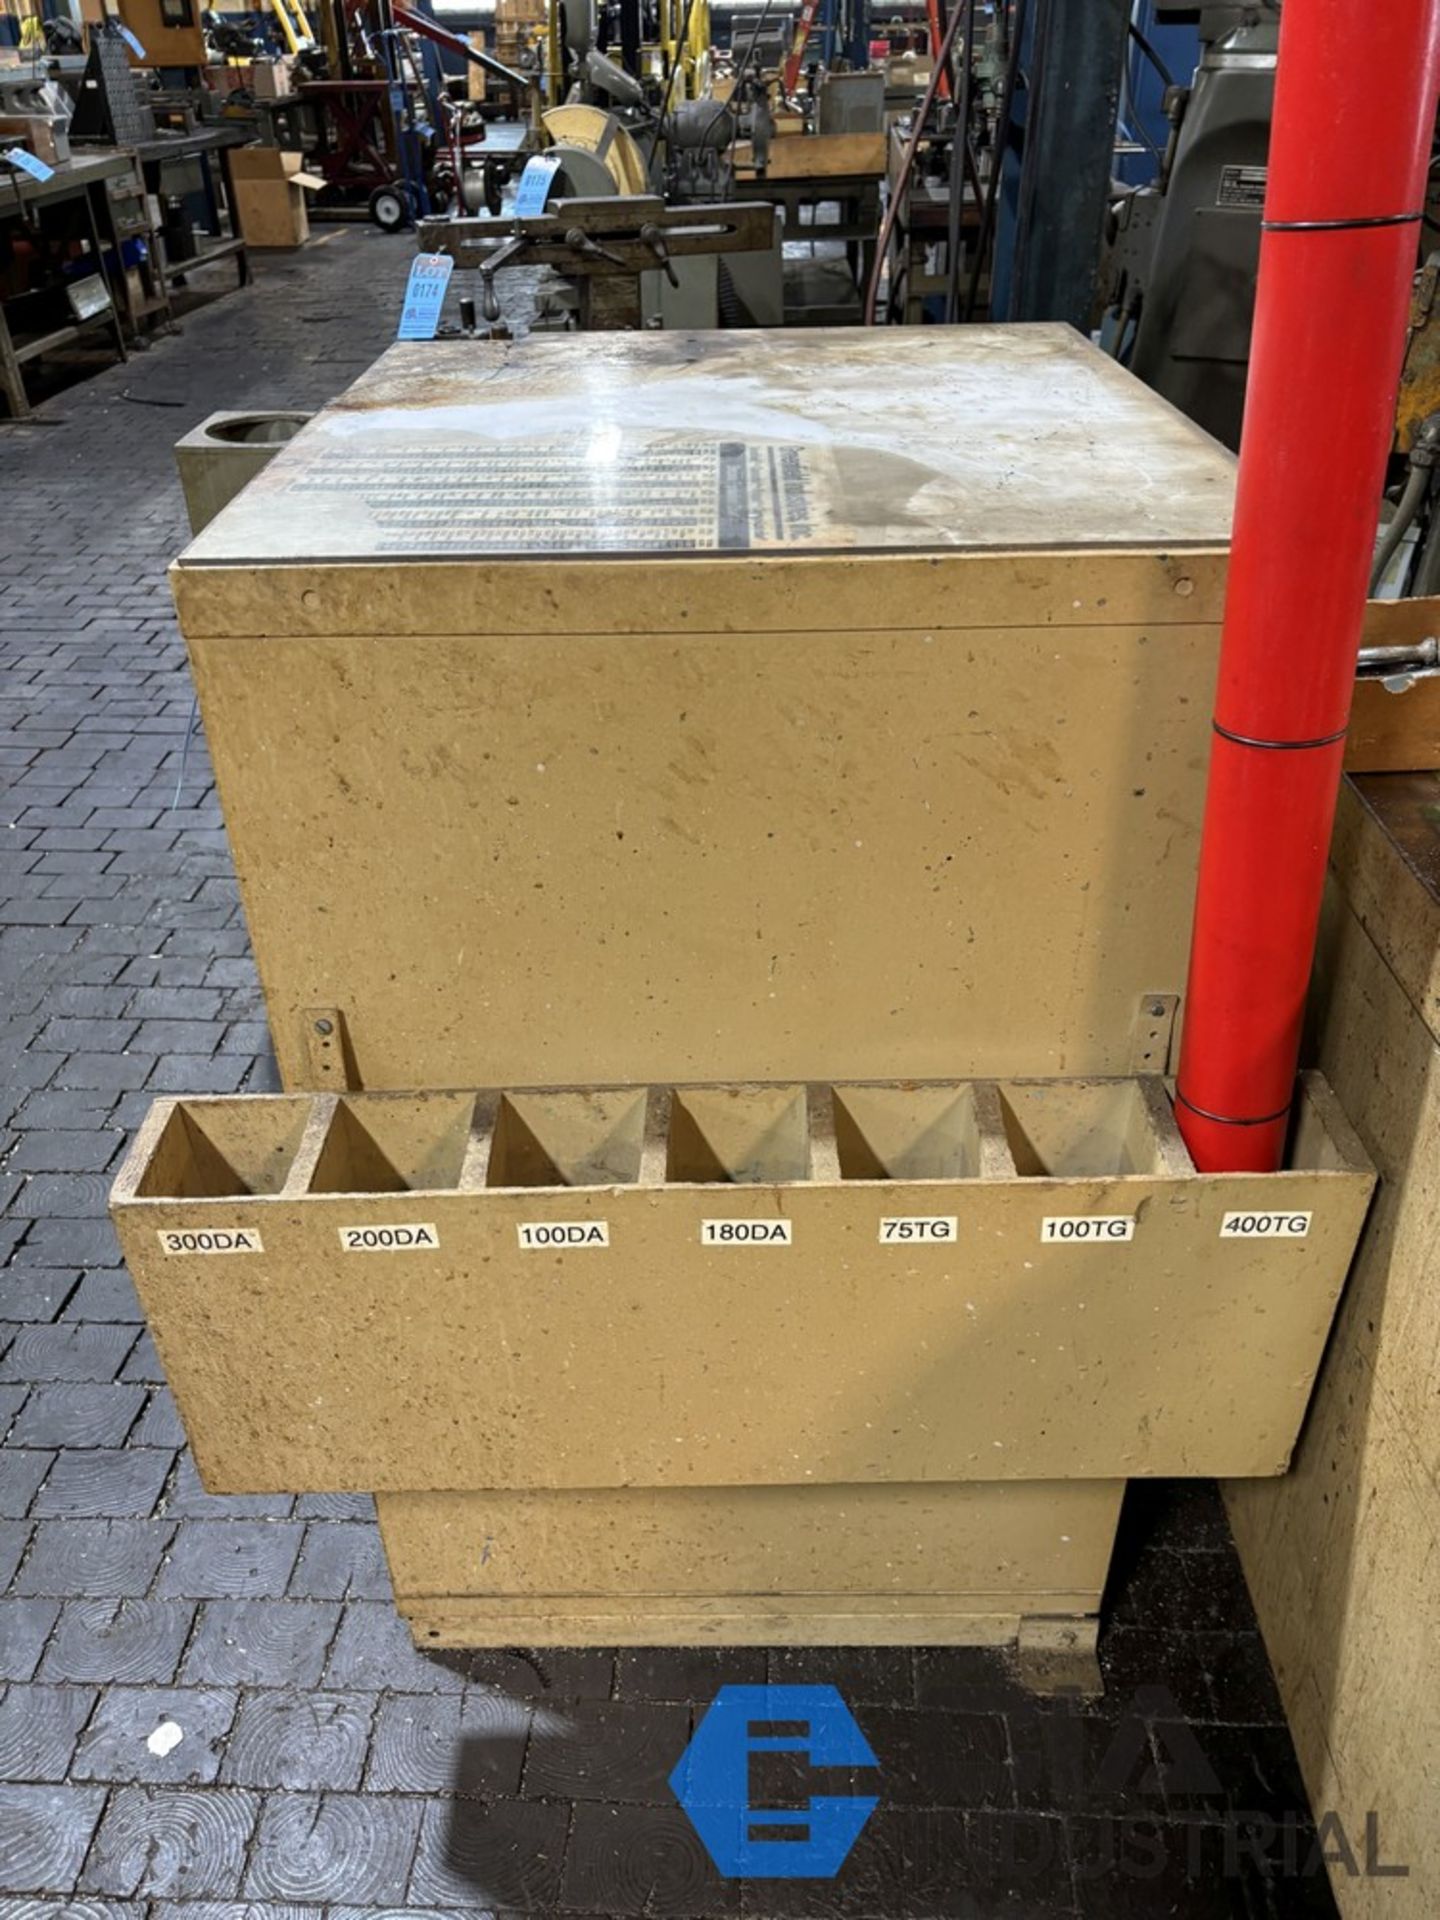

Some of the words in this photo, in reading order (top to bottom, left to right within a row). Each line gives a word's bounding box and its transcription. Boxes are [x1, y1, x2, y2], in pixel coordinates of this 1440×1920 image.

[412, 283, 440, 298] 0174
[706, 1224, 787, 1241] 180DA
[883, 1221, 949, 1239] 75TG
[1047, 1220, 1127, 1238] 100TG
[1224, 1215, 1308, 1233] 400TG
[166, 1232, 252, 1251] 300DA
[347, 1228, 432, 1247] 200DA
[522, 1226, 604, 1244] 100DA
